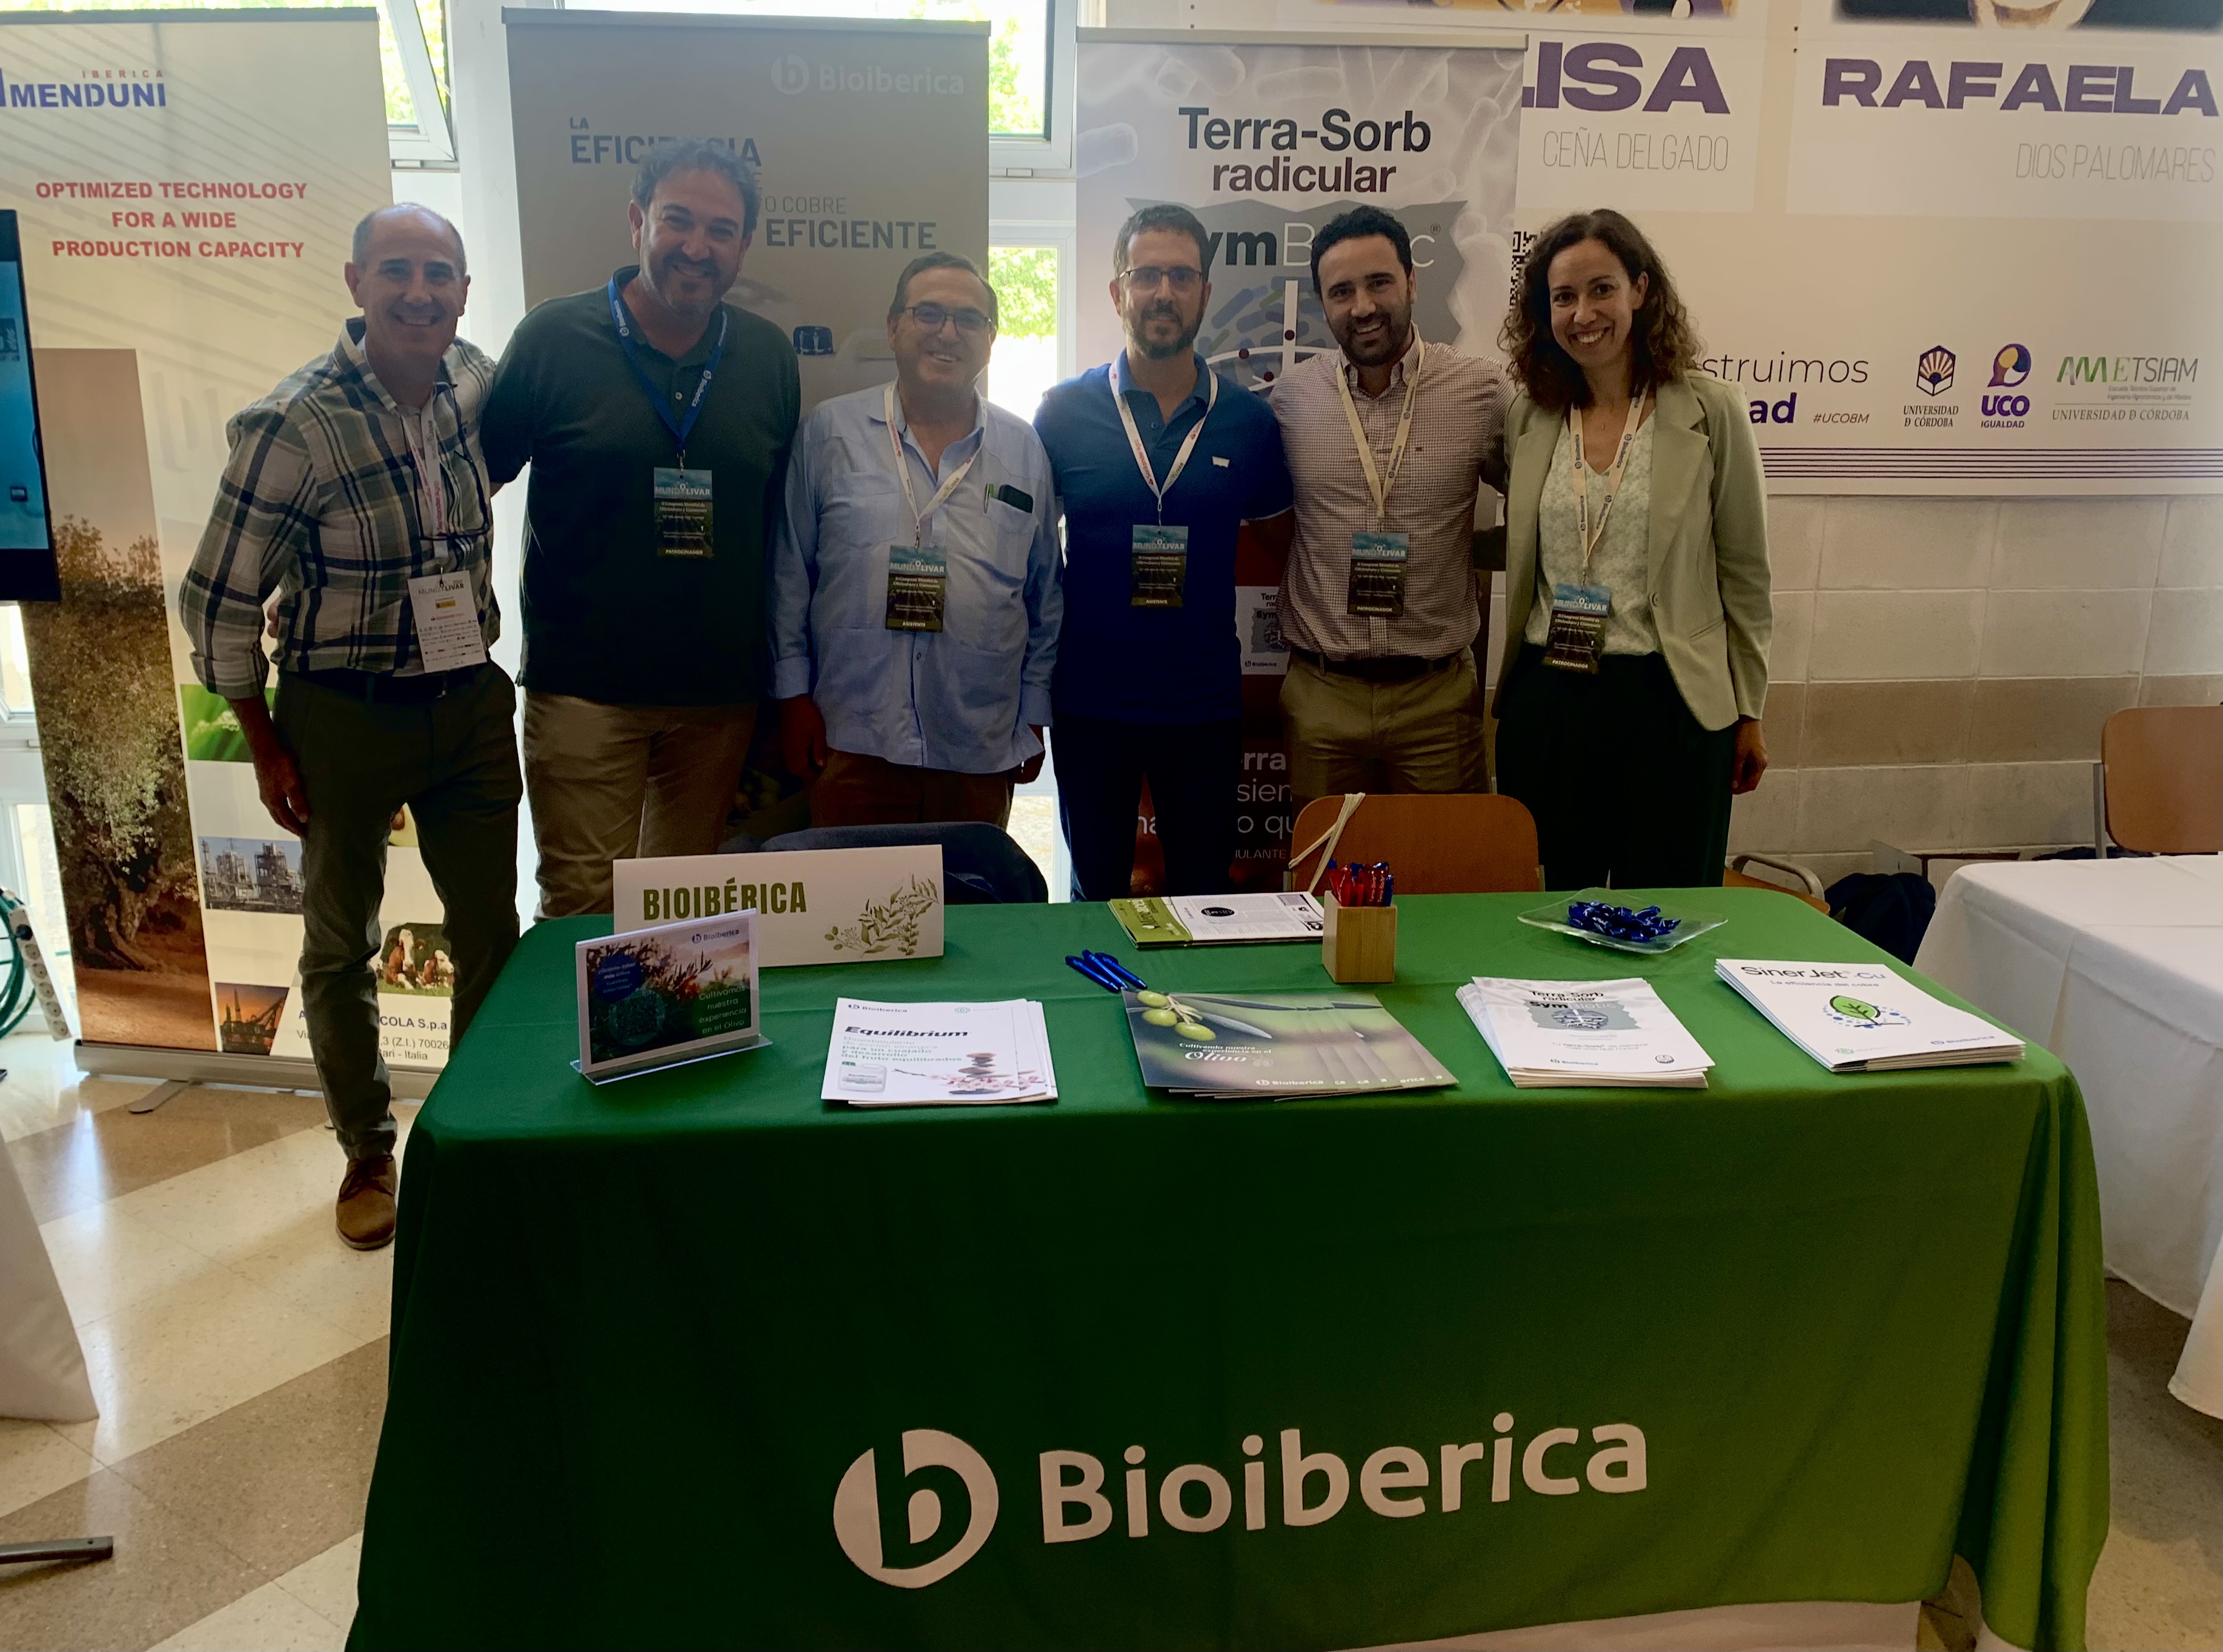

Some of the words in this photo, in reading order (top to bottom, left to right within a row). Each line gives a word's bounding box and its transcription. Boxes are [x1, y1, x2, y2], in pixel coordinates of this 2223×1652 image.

[82, 70, 163, 78] IBERICA
[819, 64, 964, 94] Bioiberica
[0, 68, 166, 107] MENDUNI
[1822, 58, 2219, 116] RAFAELA
[569, 117, 590, 130] LA
[1178, 107, 1431, 152] Terra-Sorb
[1543, 127, 1607, 167] CEÑA
[1617, 133, 1729, 171] DELGADO
[2016, 143, 2067, 179] DIOS
[2073, 144, 2216, 182] PALOMARES
[1212, 156, 1397, 193] radicular
[36, 182, 153, 199] OPTIMIZED
[158, 182, 307, 199] TECHNOLOGY
[782, 196, 847, 214] COBRE
[111, 211, 156, 228] FOR
[162, 211, 176, 228] A
[181, 212, 236, 228] WIDE
[766, 218, 937, 250] EFICIENTE
[52, 241, 191, 257] PRODUCTION
[199, 241, 304, 257] CAPACITY
[1749, 392, 1797, 423] ad
[1904, 405, 1959, 415] UNIVERSIDAD
[1981, 395, 2030, 416] UCO
[1813, 413, 1870, 424] #UCO8M
[1914, 416, 1953, 427] CÓRDOBA
[2052, 410, 2126, 420] UNIVERSIDAD
[2140, 408, 2190, 420] CÓRDOBA
[1241, 752, 1286, 770] rra
[1265, 816, 1293, 839] qu
[643, 877, 806, 921] BIOIBÉRICA
[703, 929, 740, 941] Bioiberica
[699, 986, 746, 1000] Cultivamos
[707, 998, 739, 1010] nuestra
[379, 1016, 416, 1028] COLA
[699, 1008, 747, 1023] experiencia
[723, 1019, 745, 1029] Olivo
[845, 1026, 968, 1037] Equilibrium
[419, 1039, 449, 1050] 70026
[379, 1049, 395, 1058] ari
[405, 1050, 428, 1060] Italia
[1185, 1051, 1247, 1061] Olivo
[1040, 1411, 1647, 1543] Bioiberica
